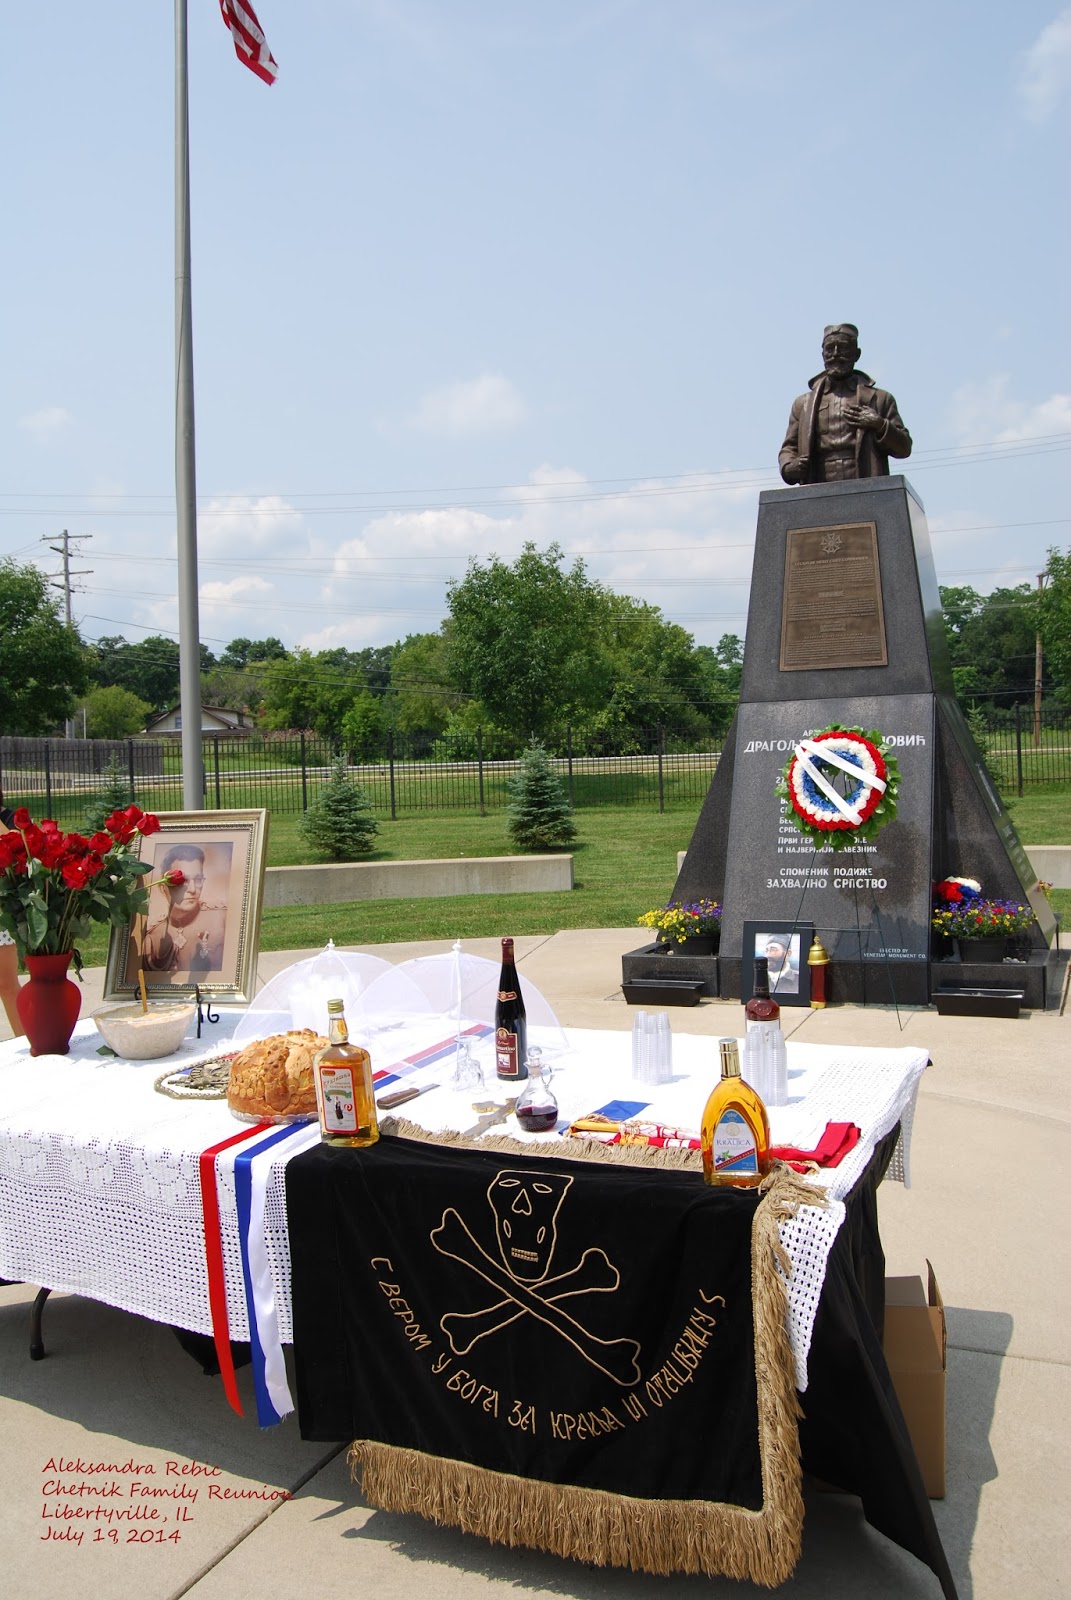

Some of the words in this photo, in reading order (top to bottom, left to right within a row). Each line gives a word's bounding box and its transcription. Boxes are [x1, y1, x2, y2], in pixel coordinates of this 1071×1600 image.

[744, 740, 799, 753] ДРАГОЉ
[780, 868, 829, 876] СПОМЕНИК
[833, 868, 873, 876] ПОДИЖЕ
[766, 878, 828, 888] ЗАХВАЛНО
[833, 878, 888, 889] СРПСТВО
[378, 1280, 432, 1351] ВЕРОМ
[446, 1369, 501, 1418] БОГА
[507, 1400, 536, 1435] ЗА
